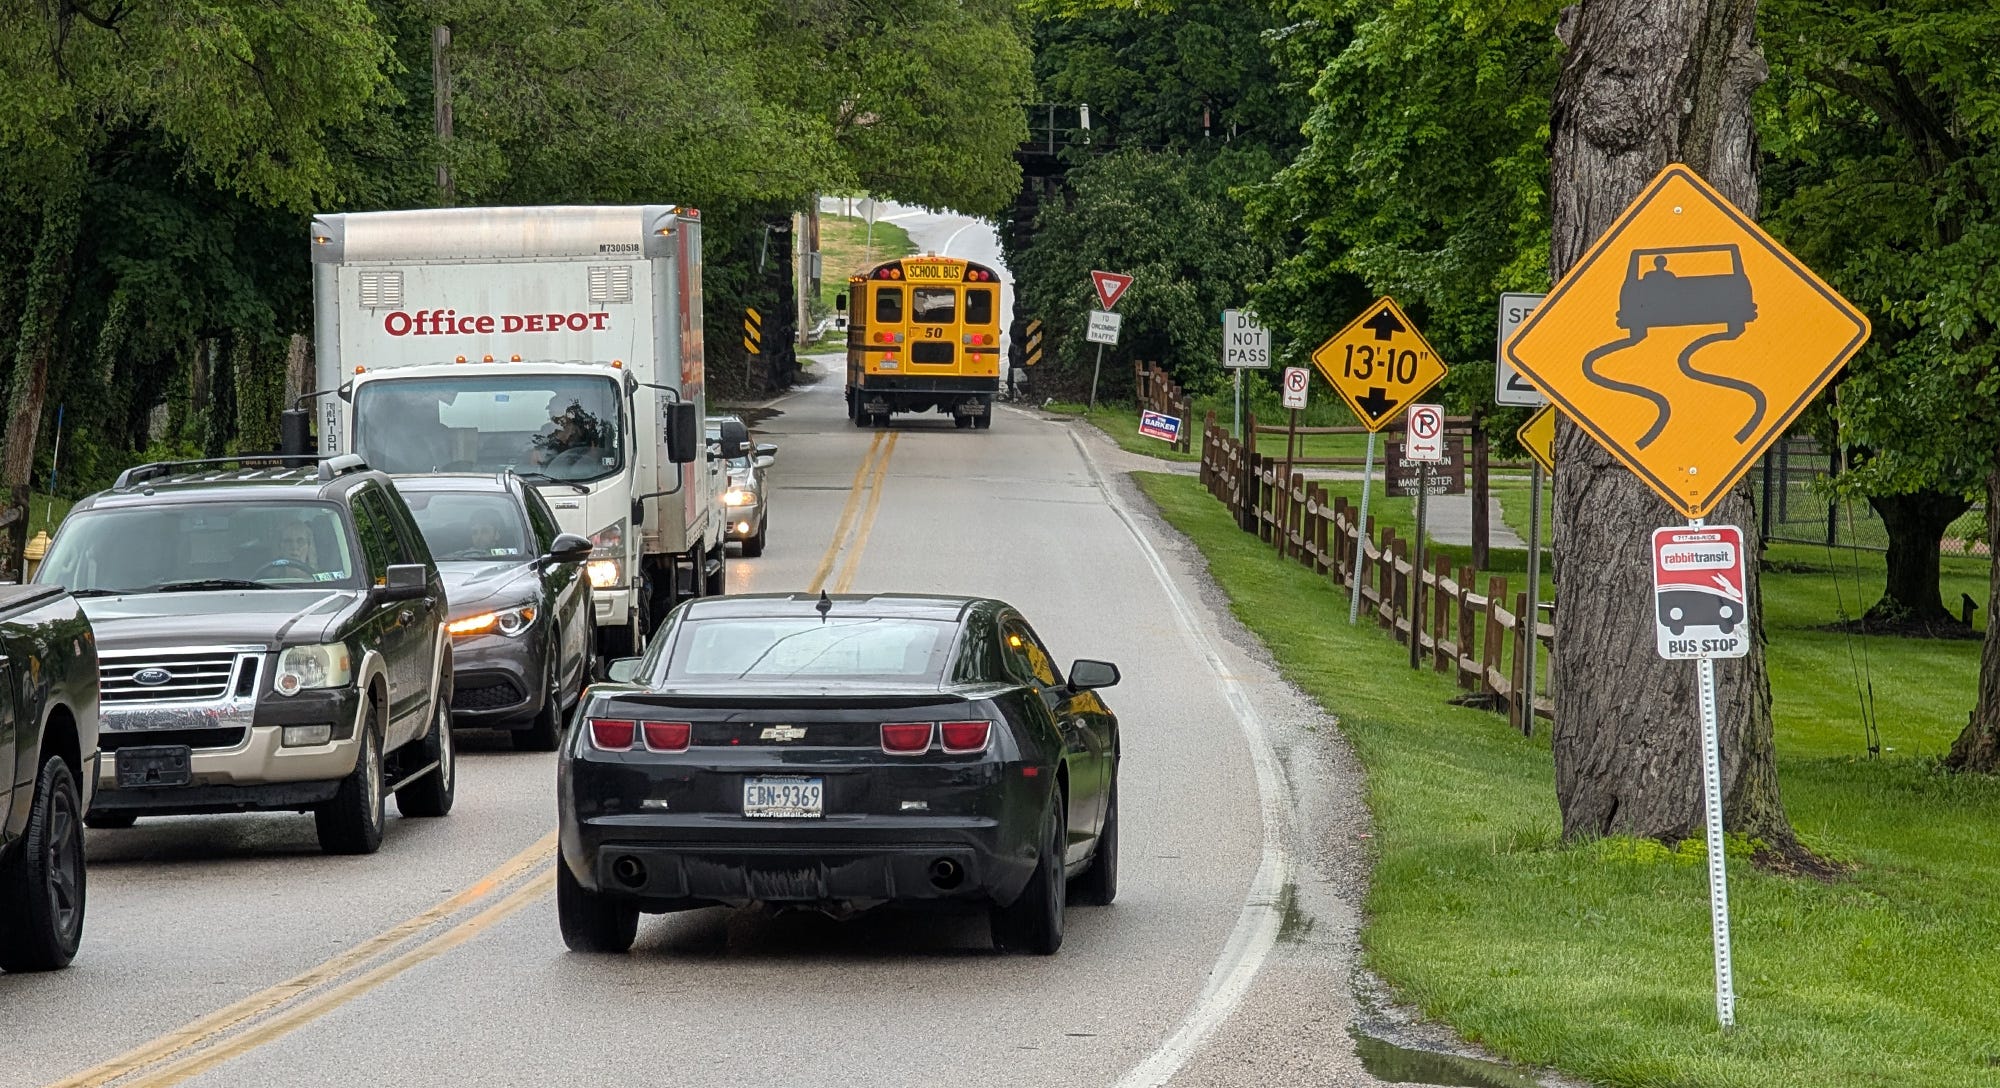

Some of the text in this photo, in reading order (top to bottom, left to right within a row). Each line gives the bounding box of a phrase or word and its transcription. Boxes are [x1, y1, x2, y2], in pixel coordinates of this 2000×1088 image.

[600, 244, 639, 252] M7300518
[910, 266, 959, 279] SCHOOL BUS
[384, 309, 609, 336] Office DEPOT
[1091, 322, 1117, 332] ONCOMING
[1238, 315, 1258, 329] DO
[925, 327, 943, 338] 50
[1091, 332, 1115, 341] TRAFFIC
[1233, 332, 1262, 346] NOT
[1228, 348, 1267, 362] PASS
[1145, 418, 1176, 432] BARKER
[1399, 456, 1451, 467] RECRTION
[1414, 467, 1437, 476] AEA
[1398, 476, 1452, 487] MANCESTER
[1405, 486, 1447, 496] TOSHIP
[1665, 551, 1729, 564] rabbittransit
[1669, 638, 1739, 653] BUS STOP
